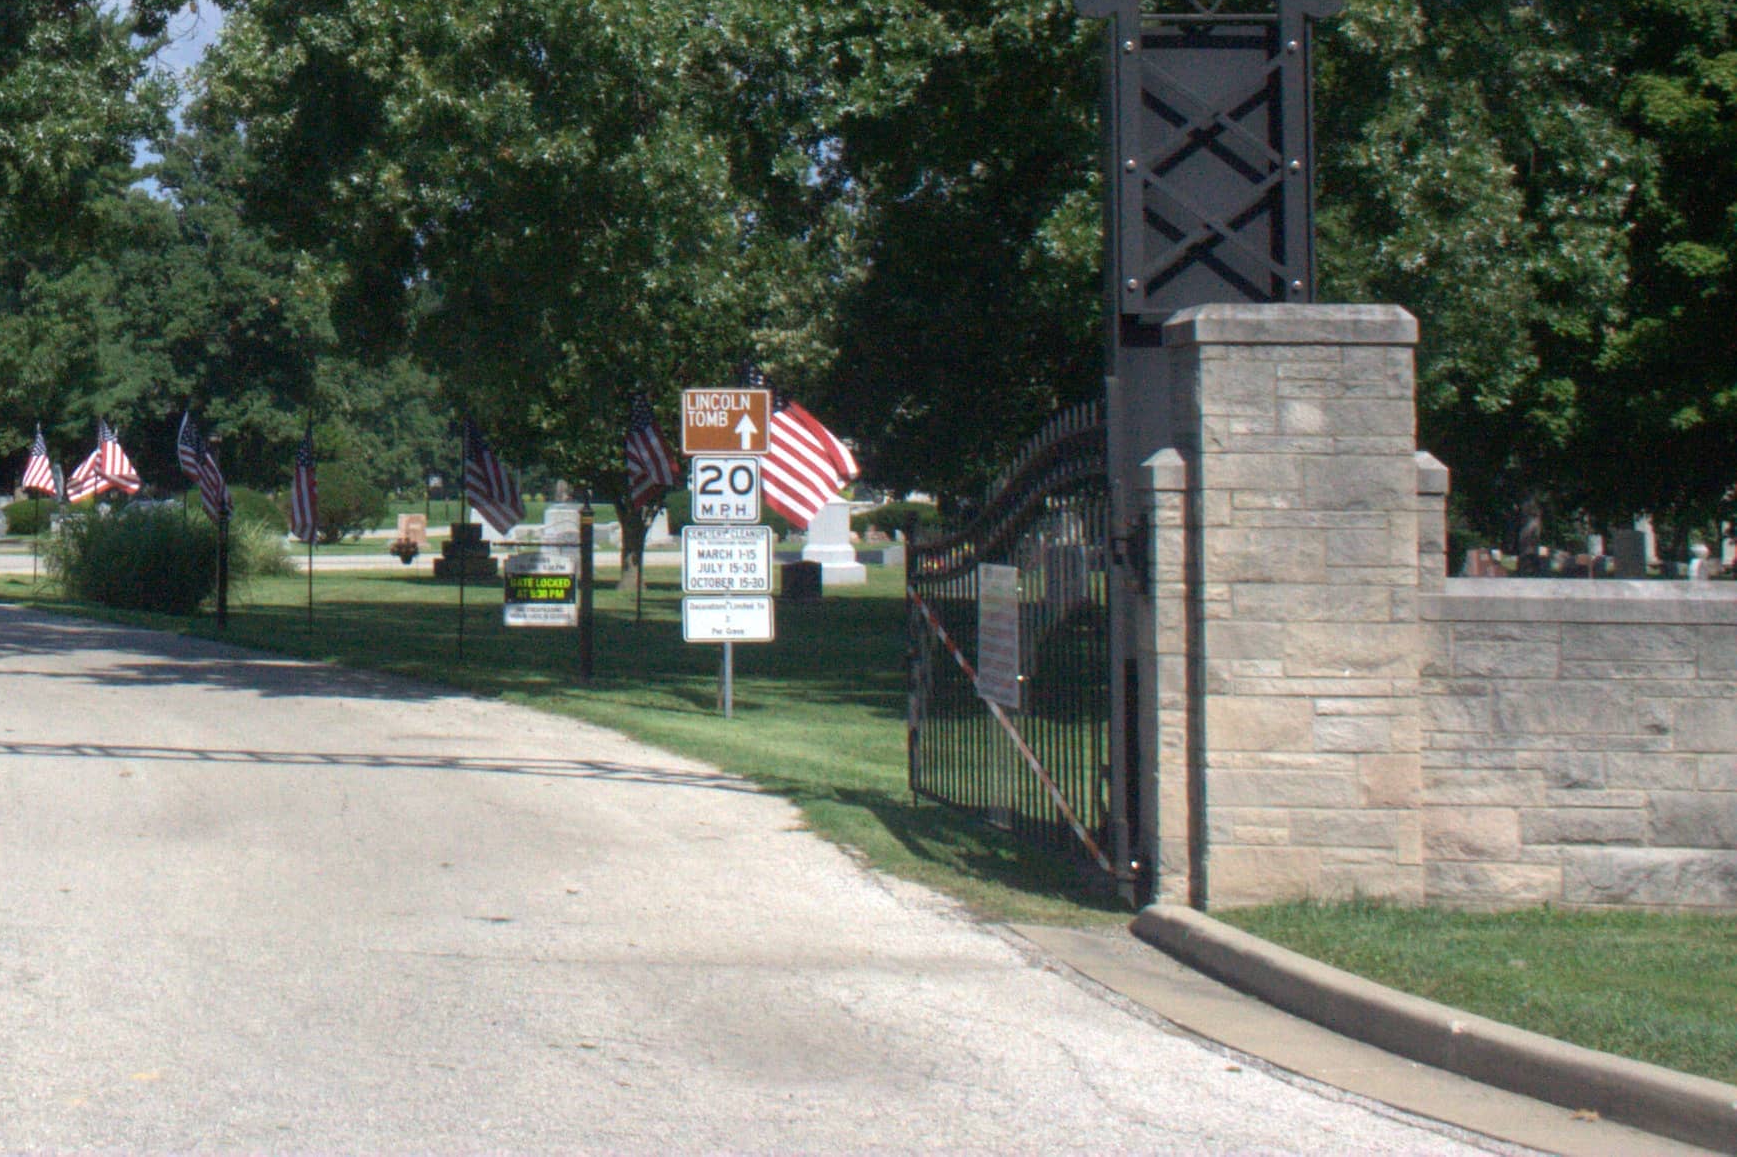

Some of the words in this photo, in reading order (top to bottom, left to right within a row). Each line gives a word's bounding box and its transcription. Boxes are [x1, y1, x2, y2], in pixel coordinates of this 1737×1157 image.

[687, 393, 750, 410] LINCOLN
[687, 411, 728, 427] TOMB
[698, 464, 754, 496] 20
[697, 548, 733, 559] MARCH
[738, 548, 757, 560] 1-15
[697, 562, 723, 574] JULY
[729, 562, 757, 574] 15-30
[535, 576, 571, 588] LOCKED
[690, 576, 735, 588] OCTOBER
[739, 576, 765, 588] 15-30
[549, 589, 565, 600] PM
